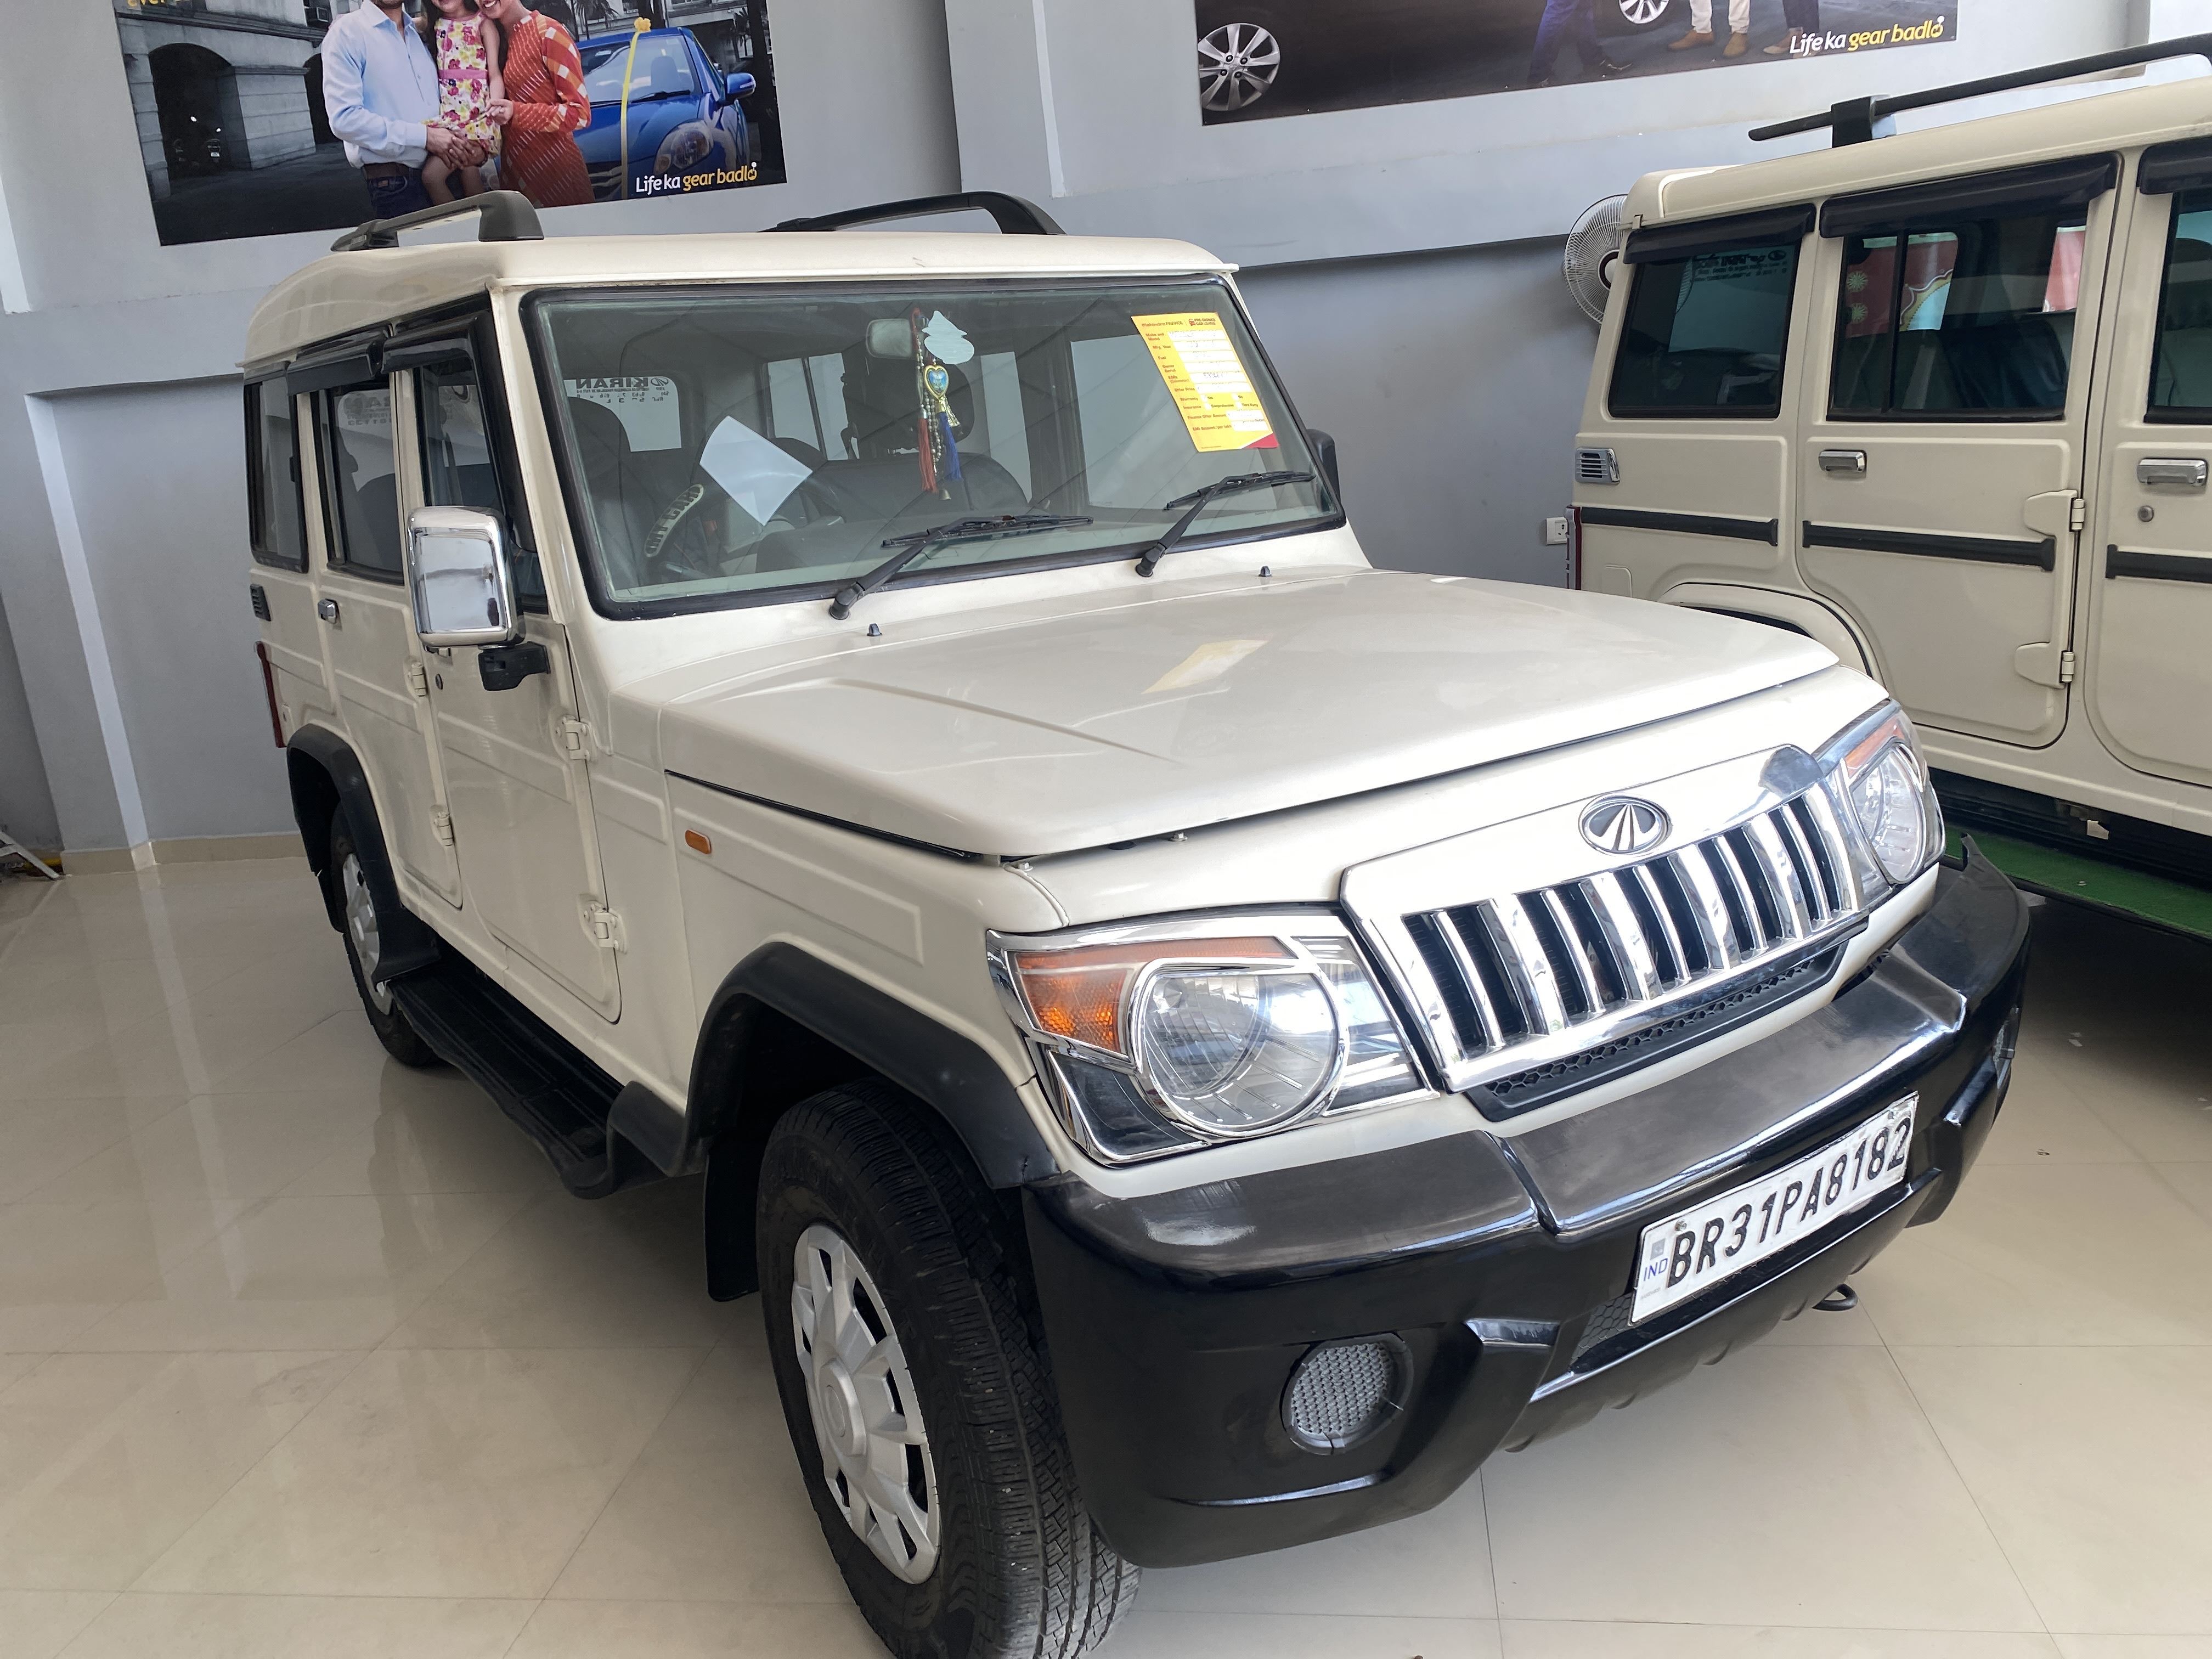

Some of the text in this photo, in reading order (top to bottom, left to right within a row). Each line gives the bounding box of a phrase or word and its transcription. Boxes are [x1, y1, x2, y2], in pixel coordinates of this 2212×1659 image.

[1847, 29, 1891, 52] gear
[1891, 16, 1945, 42] badlo
[682, 172, 715, 191] gear
[716, 162, 758, 184] badlo
[1667, 1117, 1912, 1289] BR31PA8182
[1643, 1257, 1668, 1282] IND
